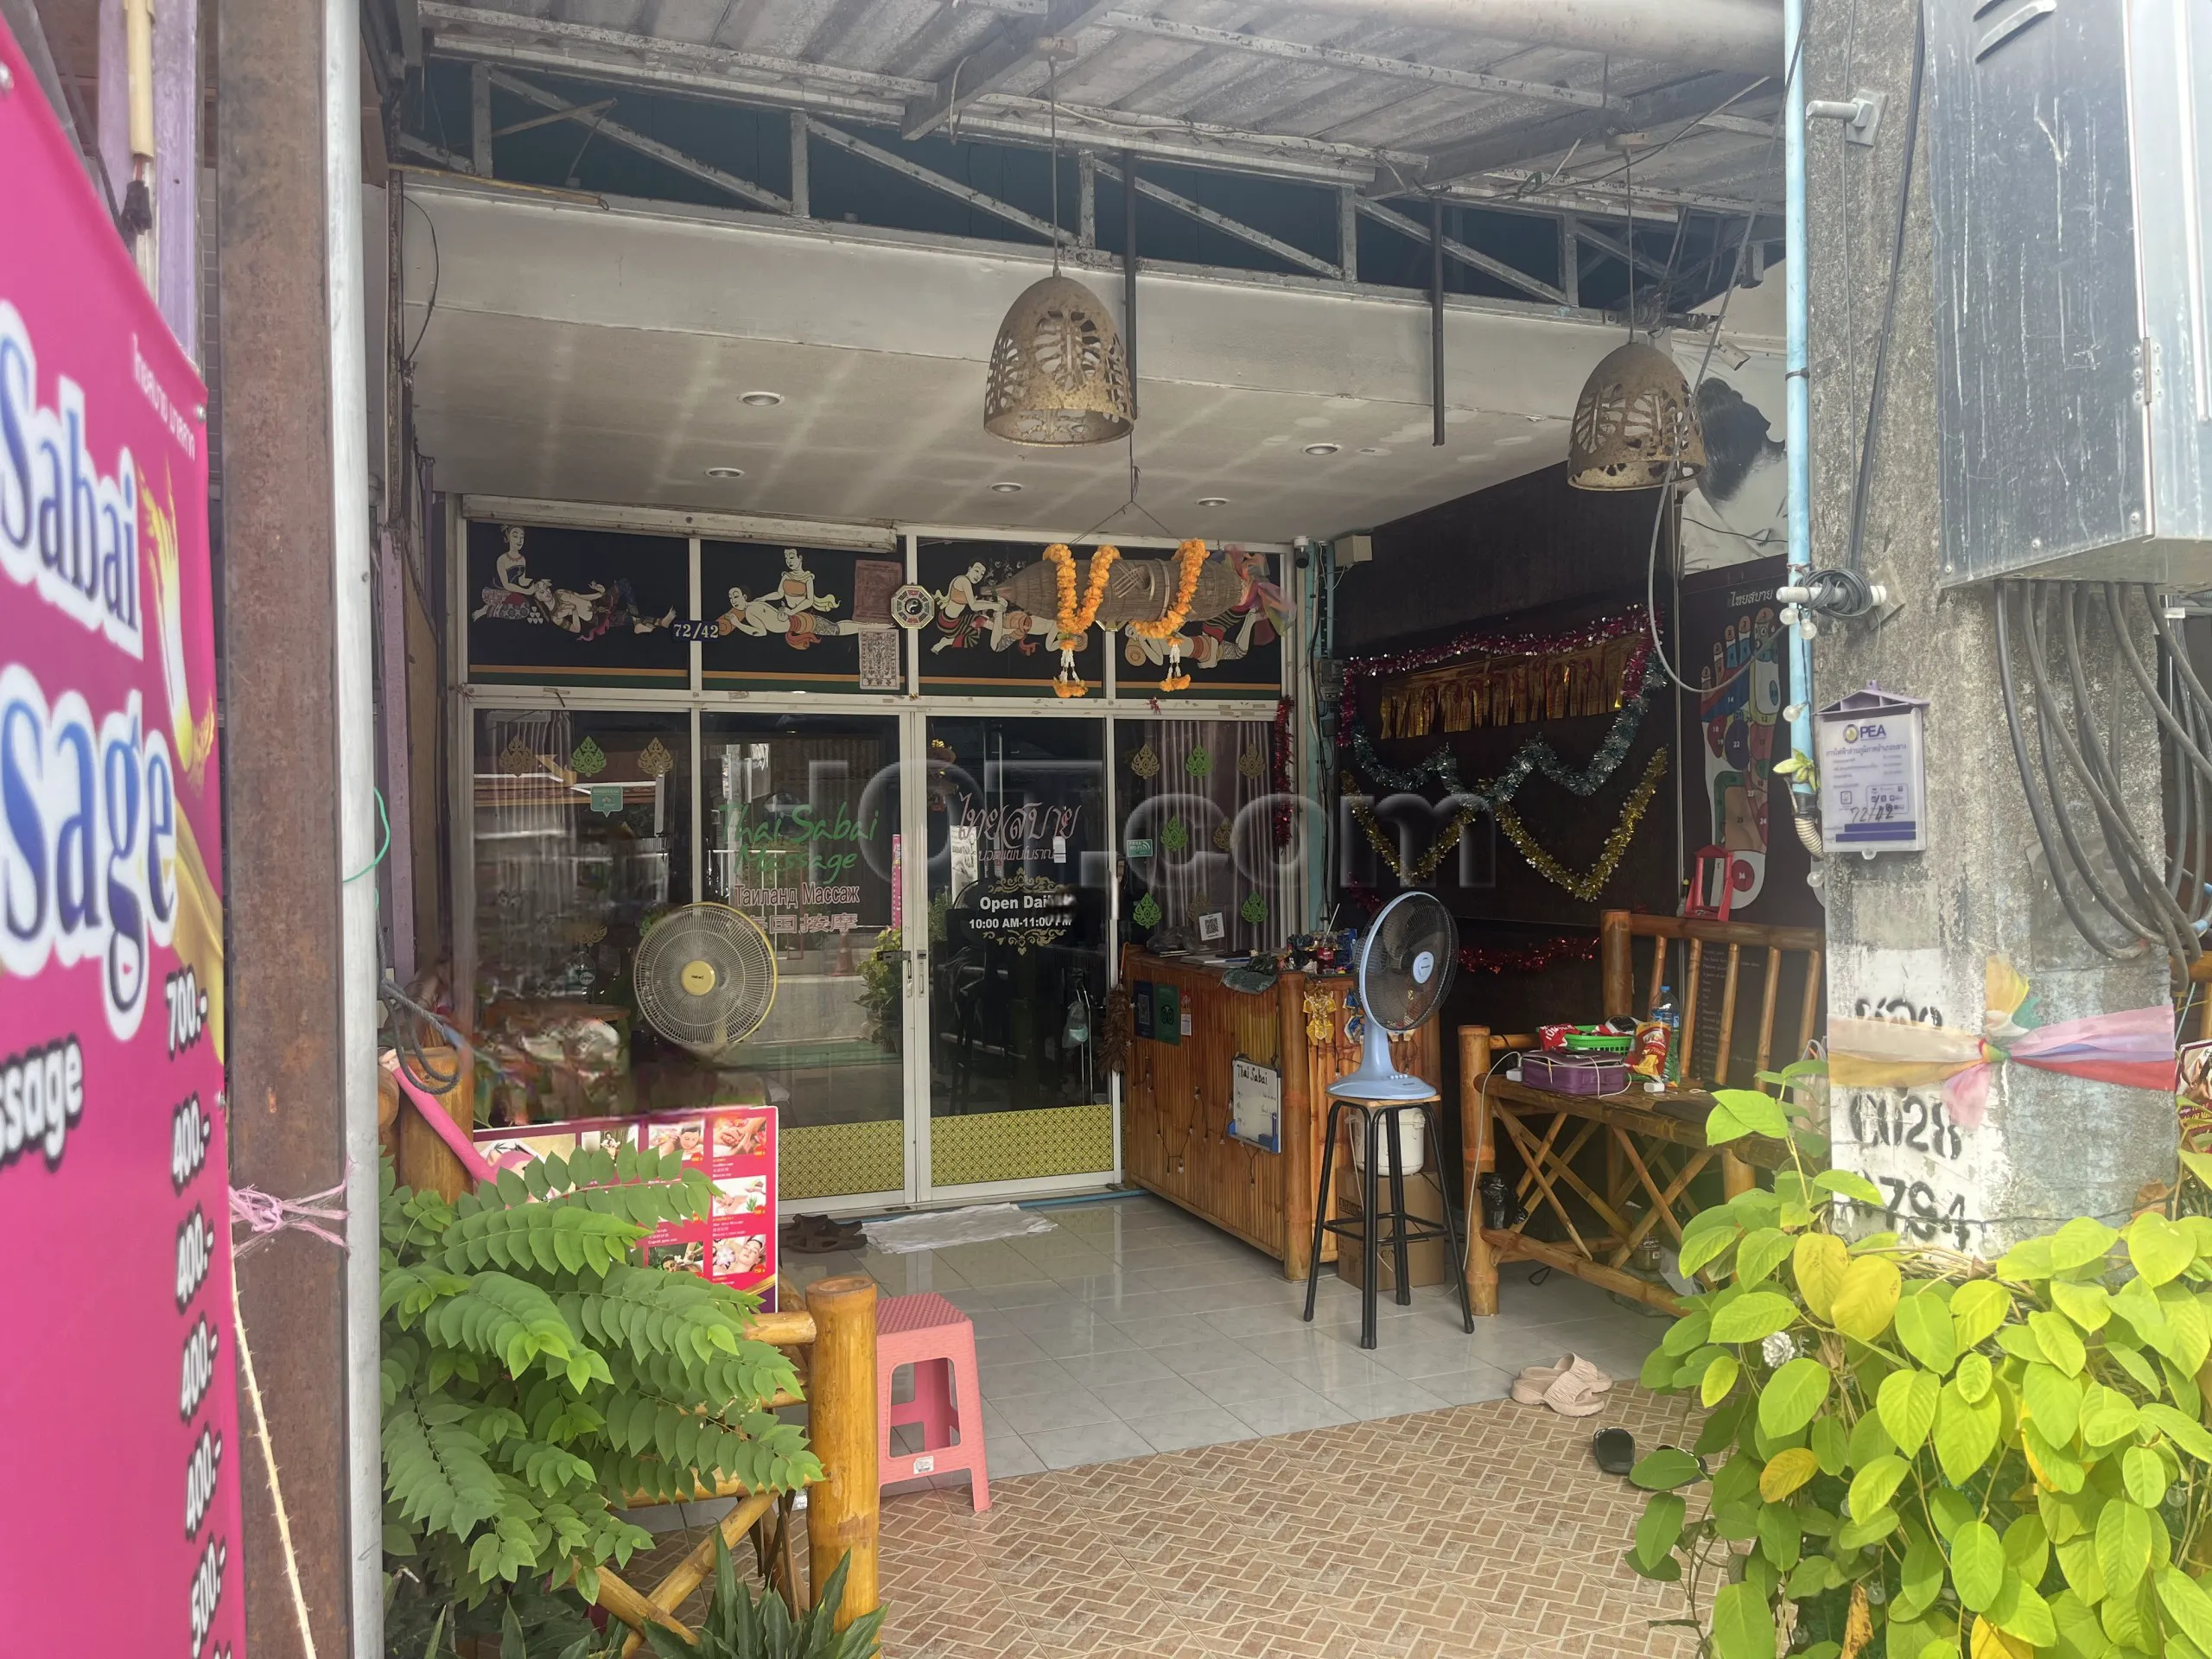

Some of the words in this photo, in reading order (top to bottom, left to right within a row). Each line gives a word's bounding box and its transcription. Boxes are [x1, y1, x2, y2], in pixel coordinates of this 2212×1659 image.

[0, 334, 139, 632] Sabai
[1731, 589, 1773, 607] ไทยสบาย
[674, 624, 719, 639] 72/42
[1860, 724, 1886, 738] PEA
[790, 802, 880, 842] Sabai
[734, 843, 858, 885] Massage
[734, 884, 798, 908] Таиланд
[802, 882, 860, 905] Массаж
[980, 896, 1019, 912] Open
[969, 918, 999, 929] 10:00
[1236, 1064, 1250, 1079] Thai
[1250, 1067, 1268, 1085] Sabai
